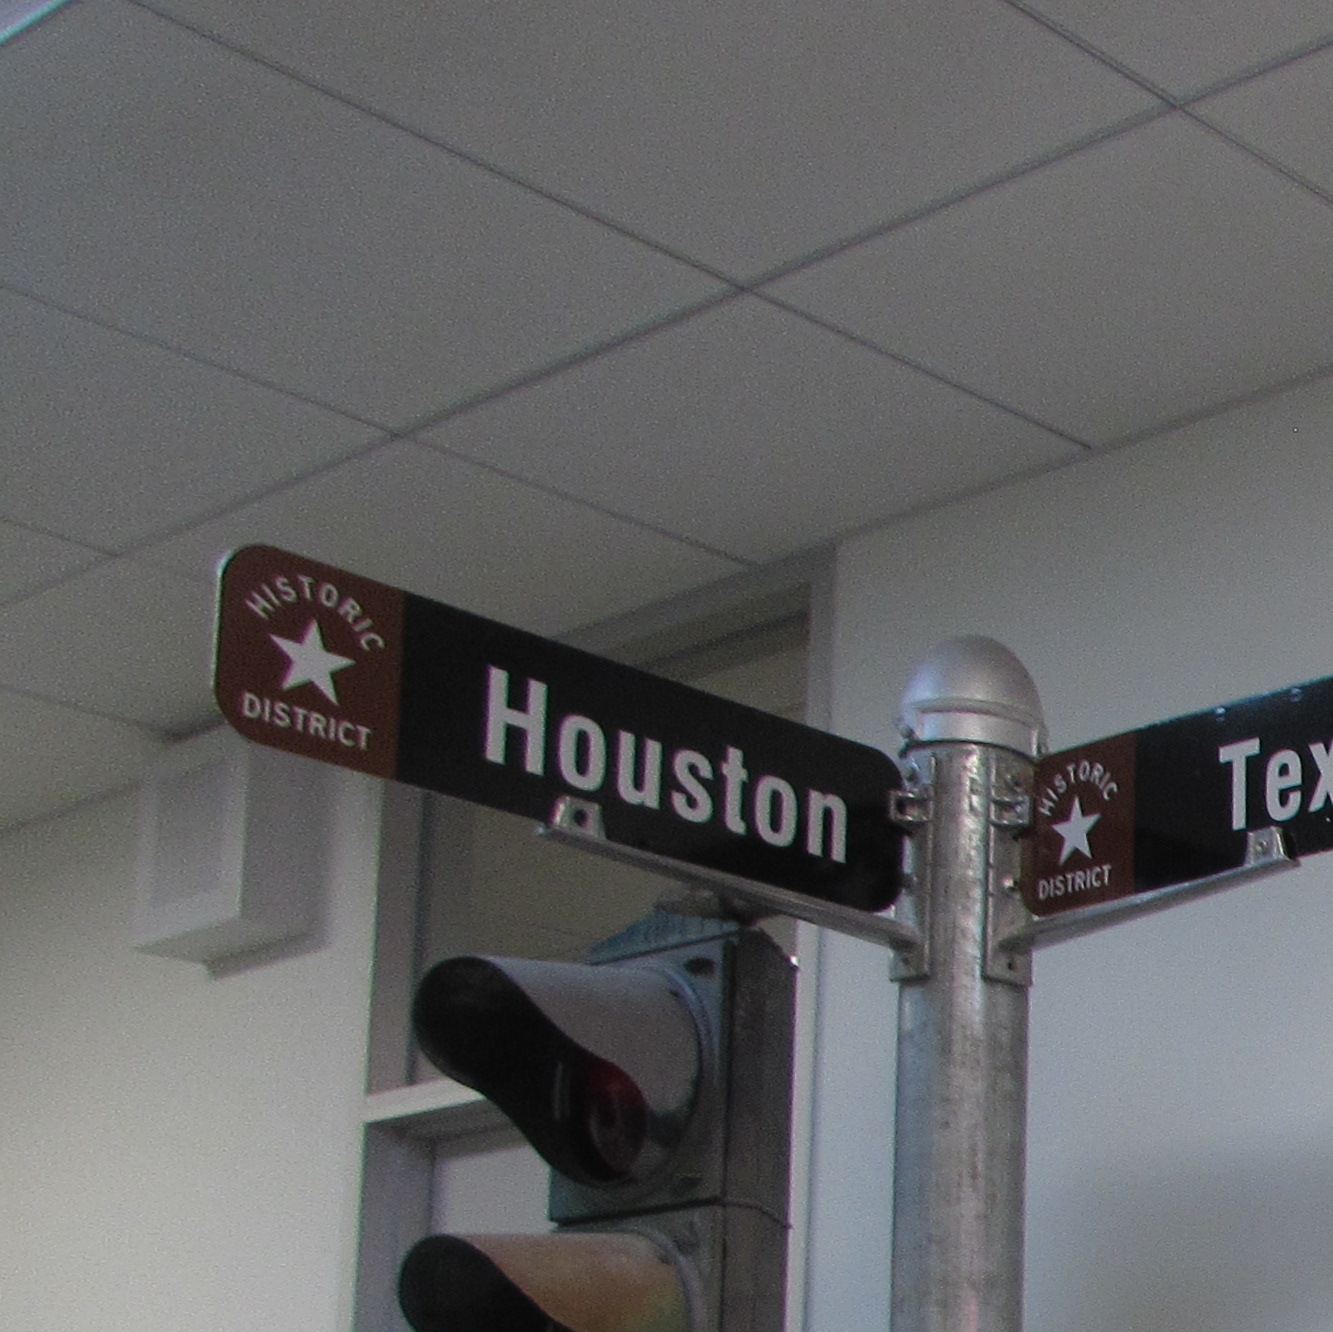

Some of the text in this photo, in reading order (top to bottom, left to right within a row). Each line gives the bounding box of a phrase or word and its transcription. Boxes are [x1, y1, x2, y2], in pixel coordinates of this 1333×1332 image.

[244, 574, 386, 651] HISTORIC
[241, 690, 373, 750] DISTRICT
[484, 664, 848, 864] Houston
[1037, 758, 1119, 817] HISTORIC
[1038, 863, 1113, 901] DISTRICT
